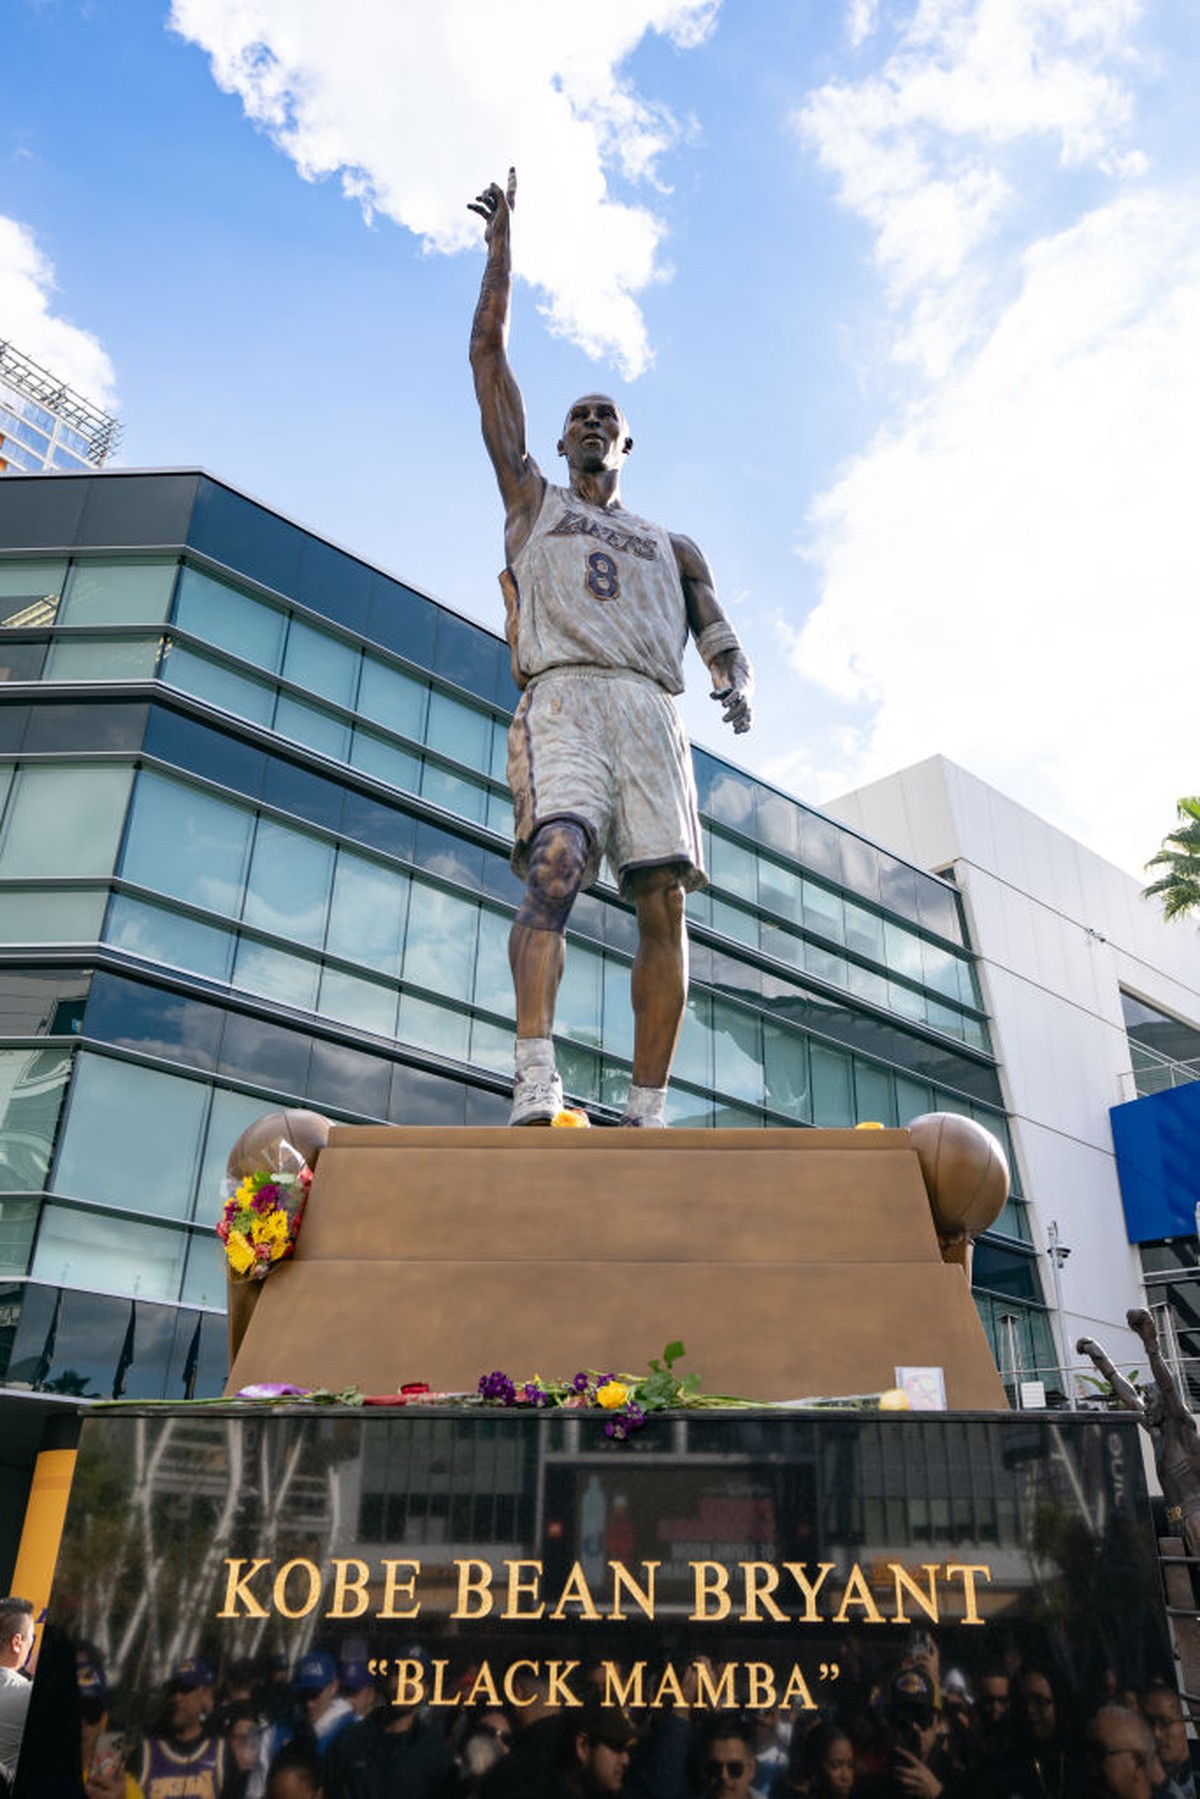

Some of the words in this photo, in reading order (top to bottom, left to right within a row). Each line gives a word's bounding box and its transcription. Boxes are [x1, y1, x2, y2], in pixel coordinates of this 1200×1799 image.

[545, 509, 658, 561] LAKERS
[584, 548, 620, 601] 8
[216, 1557, 422, 1620] KOBE
[449, 1557, 661, 1621] BEAN
[688, 1559, 992, 1626] BRYANT
[367, 1658, 584, 1708] “BLACK
[601, 1660, 840, 1711] MAMBA”
